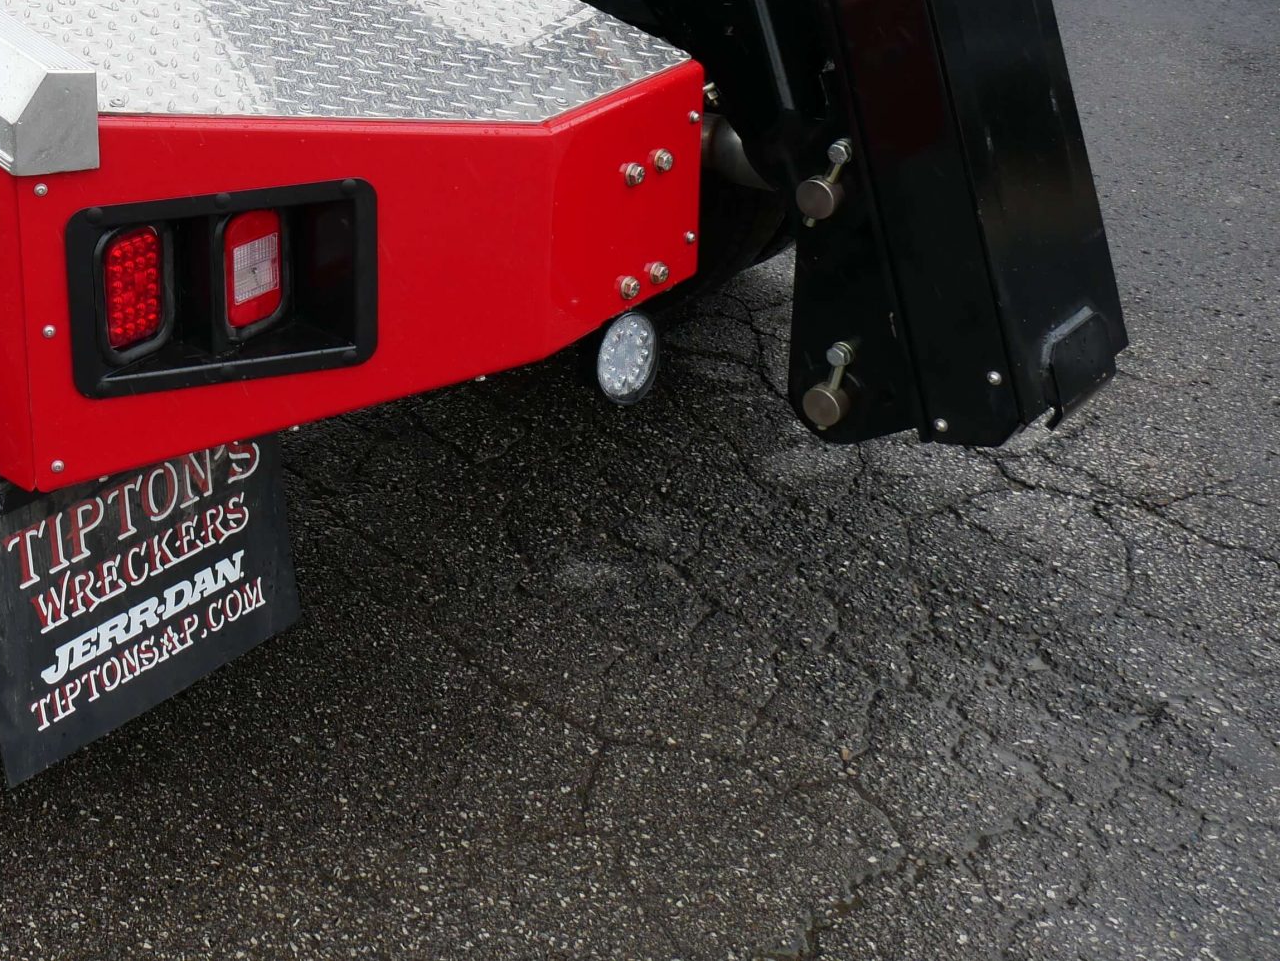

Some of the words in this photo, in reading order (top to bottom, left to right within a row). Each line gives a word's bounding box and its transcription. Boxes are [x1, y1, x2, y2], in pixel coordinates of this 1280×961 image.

[2, 441, 260, 589] TIPTON'S
[31, 492, 249, 634] WRECKERS
[30, 577, 266, 731] TIPTONSAP.COM
[41, 550, 245, 684] JERR-DAN
